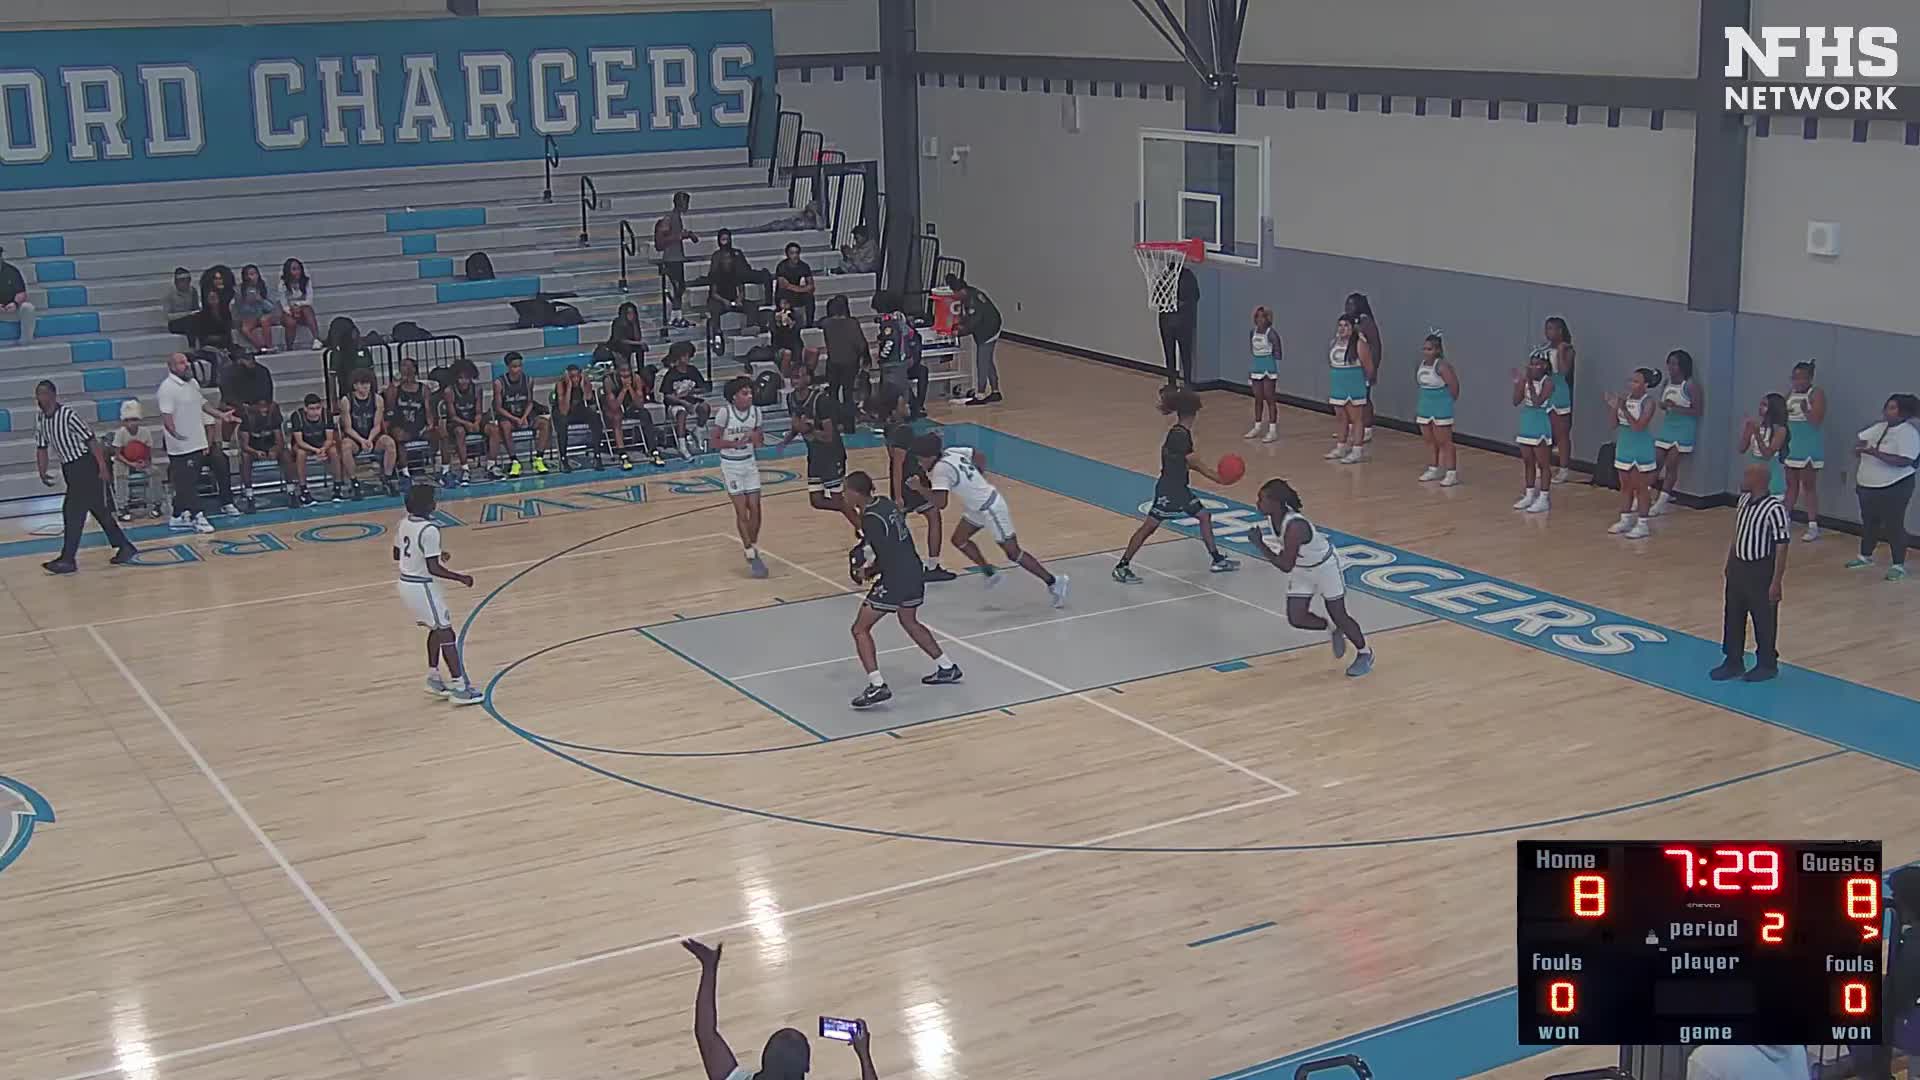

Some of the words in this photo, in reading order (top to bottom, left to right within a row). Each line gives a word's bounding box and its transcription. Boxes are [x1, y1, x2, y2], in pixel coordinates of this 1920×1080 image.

[0, 61, 205, 166] ORD
[250, 43, 758, 150] CHARGERS
[403, 536, 411, 558] 2
[1138, 497, 1668, 655] HRGERS
